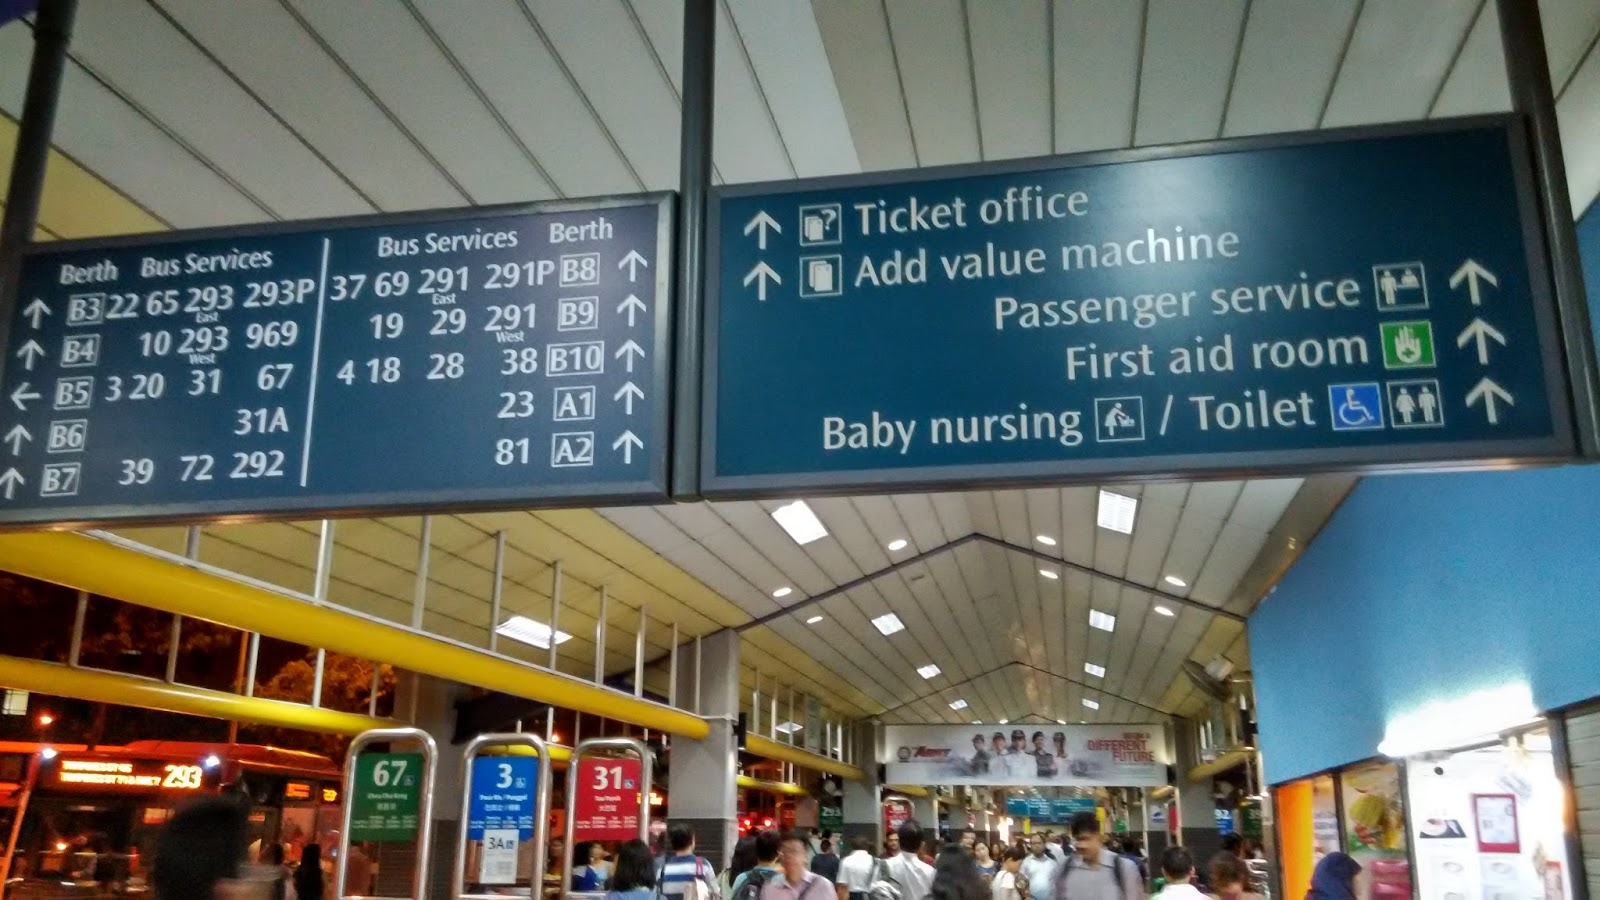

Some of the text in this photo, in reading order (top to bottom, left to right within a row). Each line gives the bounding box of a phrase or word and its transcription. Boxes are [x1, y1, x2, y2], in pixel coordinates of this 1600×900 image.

[854, 185, 1090, 236] Ticket office
[378, 227, 518, 258] Bus Services
[549, 217, 613, 244] Berth
[140, 248, 273, 278] Bus Services
[854, 225, 1240, 288] Add value machine
[60, 260, 119, 285] Berth
[330, 257, 596, 301] 37 69 291 291P B8
[69, 278, 315, 322] B3 22 65 293 293P
[432, 292, 457, 306] East
[994, 271, 1362, 329] Passenger service
[195, 311, 219, 323] East
[369, 301, 595, 340] 19 29 291 B9
[63, 321, 298, 363] B4 10 293 969
[495, 330, 525, 343] West
[188, 353, 217, 366] West
[336, 345, 602, 385] 4 18 28 38 B10
[1066, 334, 1369, 381] First aid room
[56, 363, 294, 405] B5 3 20 31 67
[497, 390, 592, 419] 23 A1
[50, 407, 289, 449] B6 31A
[823, 389, 1316, 454] Baby nursing / Toilet
[494, 437, 592, 466] 81 A2
[44, 450, 285, 492] B7 39 72 292
[1087, 739, 1146, 751] DIFFERENT
[1113, 751, 1155, 762] FUTURE
[162, 765, 202, 788] 293
[373, 760, 408, 786] 67
[496, 763, 513, 788] 3
[592, 766, 622, 790] 31
[488, 837, 505, 850] 3A
